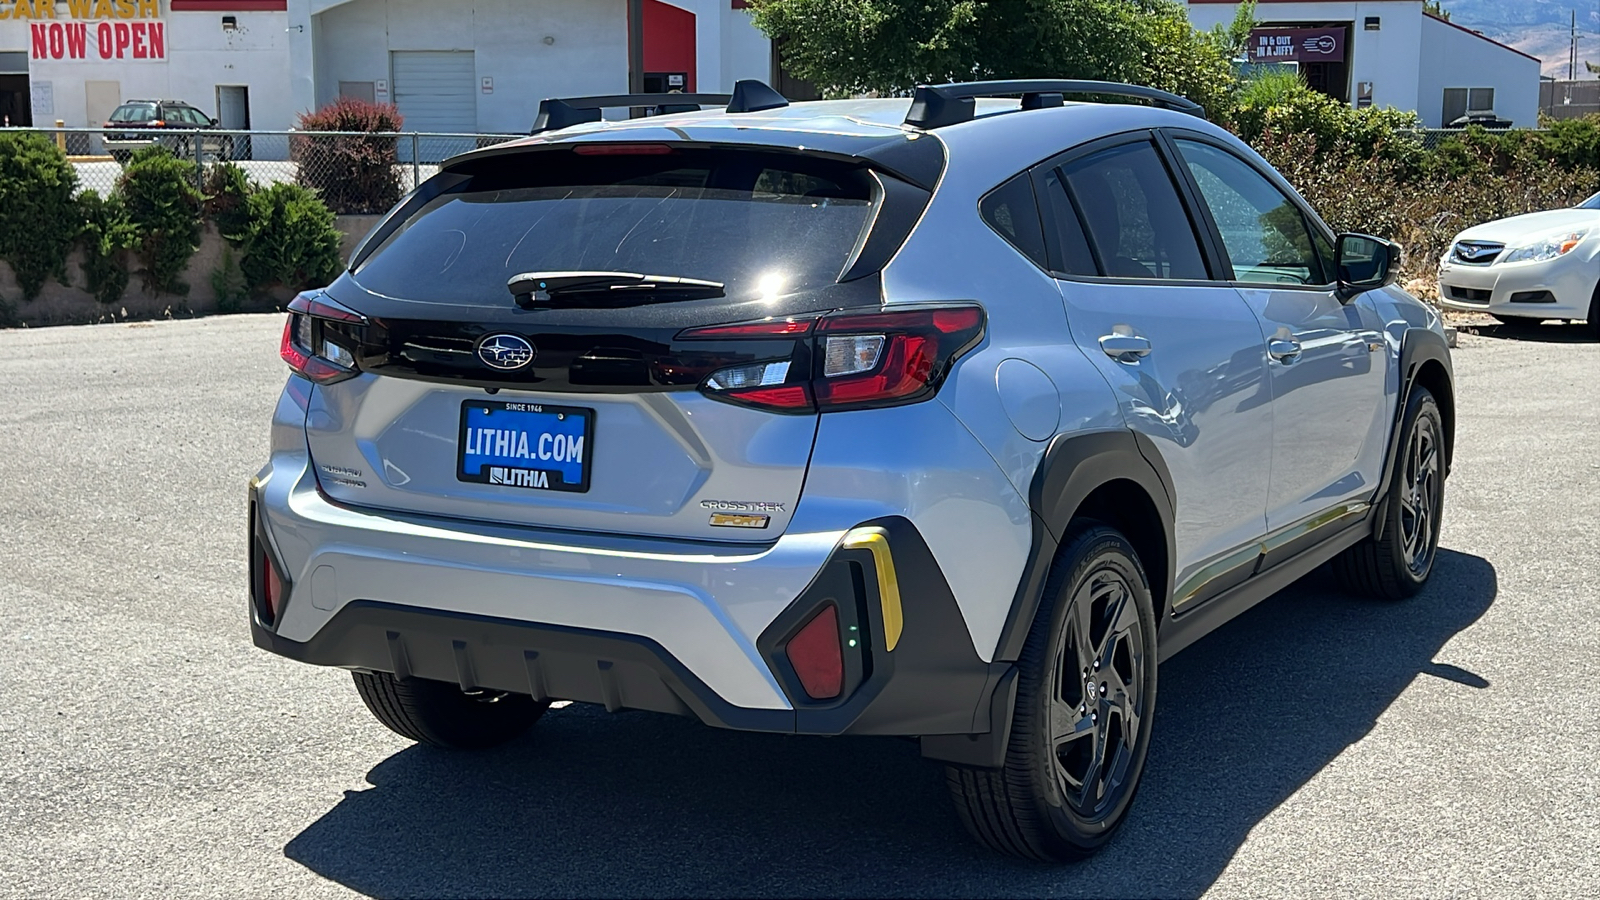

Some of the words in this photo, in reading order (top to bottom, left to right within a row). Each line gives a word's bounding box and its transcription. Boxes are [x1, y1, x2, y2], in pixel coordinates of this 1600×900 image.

[67, 0, 159, 19] WASH
[31, 22, 87, 60] NOW
[98, 22, 165, 60] OPEN
[1259, 36, 1268, 46] IN
[1269, 36, 1275, 45] &
[1276, 36, 1291, 45] OUT
[1256, 46, 1265, 57] IN
[1266, 46, 1272, 56] A
[1273, 45, 1294, 56] JIFFY
[505, 403, 526, 412] SINCE
[527, 404, 543, 413] 1946
[465, 427, 584, 463] LITHIA.COM
[321, 465, 362, 477] SUBARU
[502, 467, 549, 488] LITHIA
[700, 500, 786, 512] CROSSTREK
[713, 515, 764, 526] SPORT
